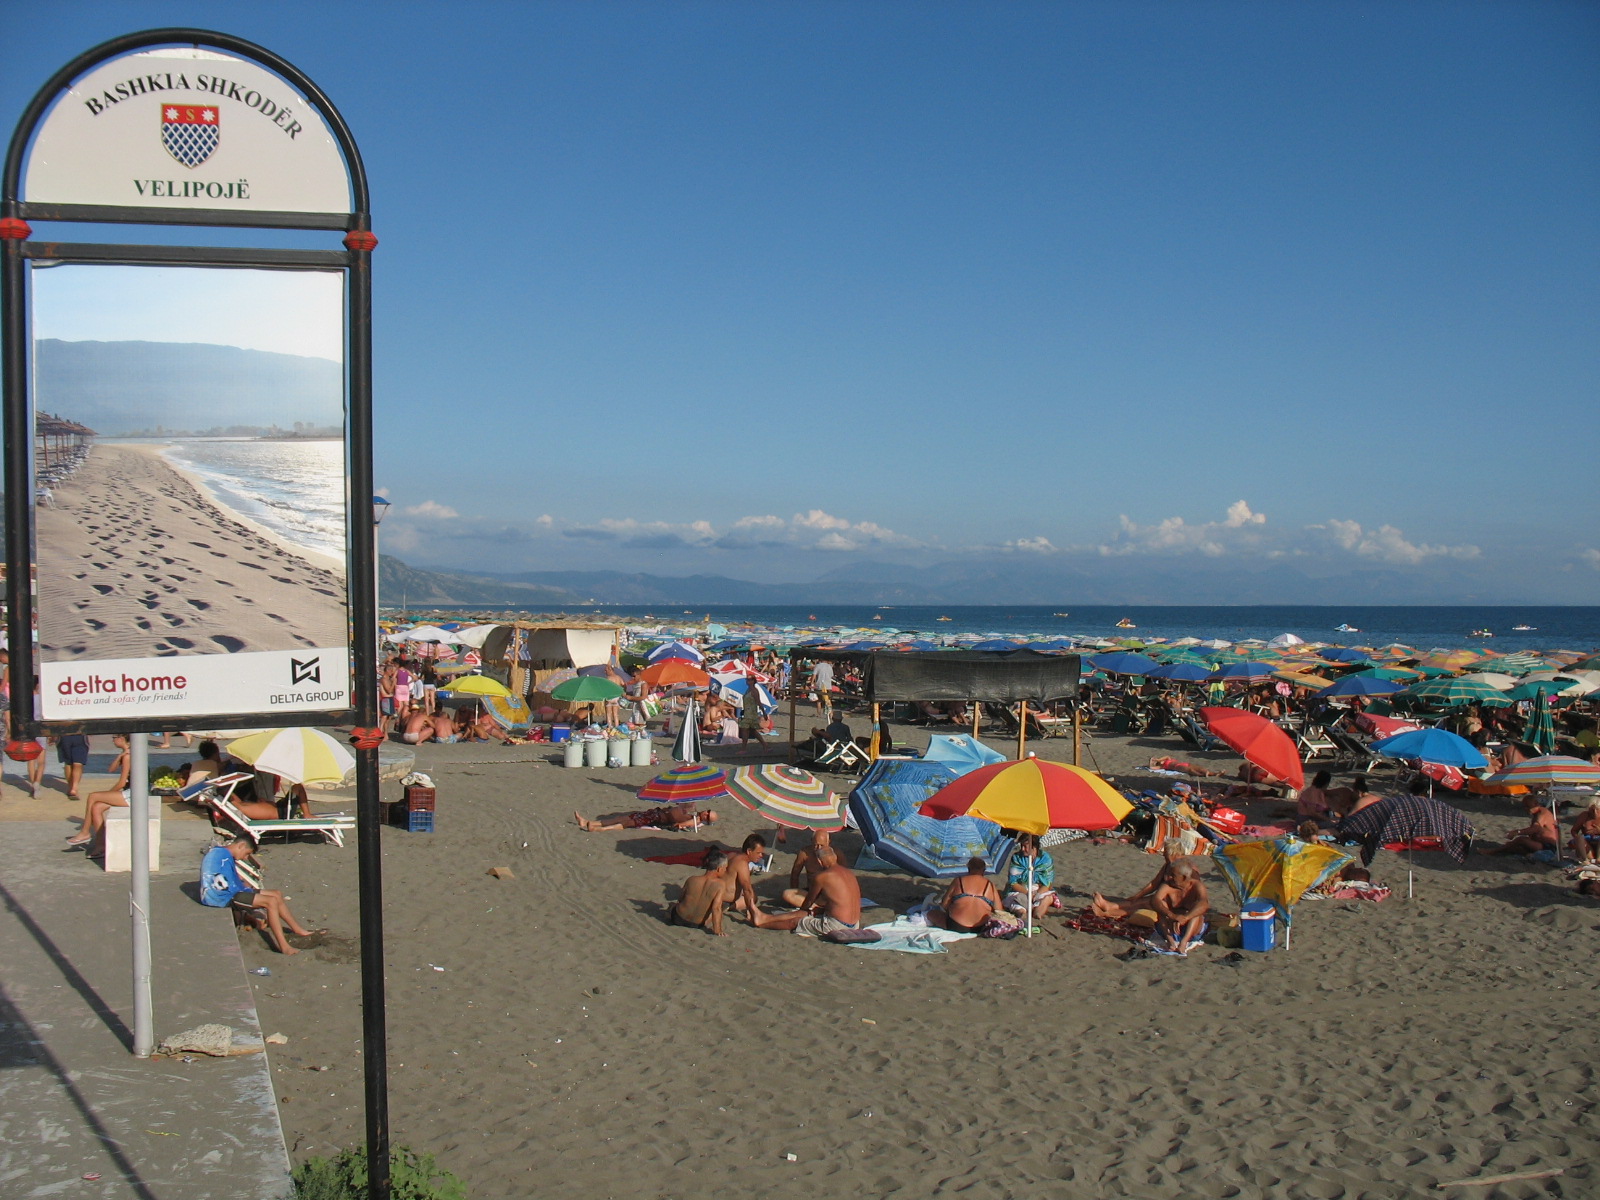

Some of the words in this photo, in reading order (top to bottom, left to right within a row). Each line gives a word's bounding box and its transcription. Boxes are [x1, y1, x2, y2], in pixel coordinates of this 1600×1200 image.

[85, 73, 191, 116] BASHKIA
[196, 74, 303, 140] SHKODËR
[185, 109, 195, 121] S
[133, 178, 250, 199] VELIPOJË
[57, 675, 117, 695] delta
[121, 673, 187, 692] home
[58, 696, 91, 706] kitchen
[93, 695, 111, 705] and
[112, 694, 135, 704] sofas
[136, 693, 151, 704] for
[151, 691, 188, 704] friends!
[270, 693, 304, 704] DELTA
[305, 690, 344, 702] GROUP
